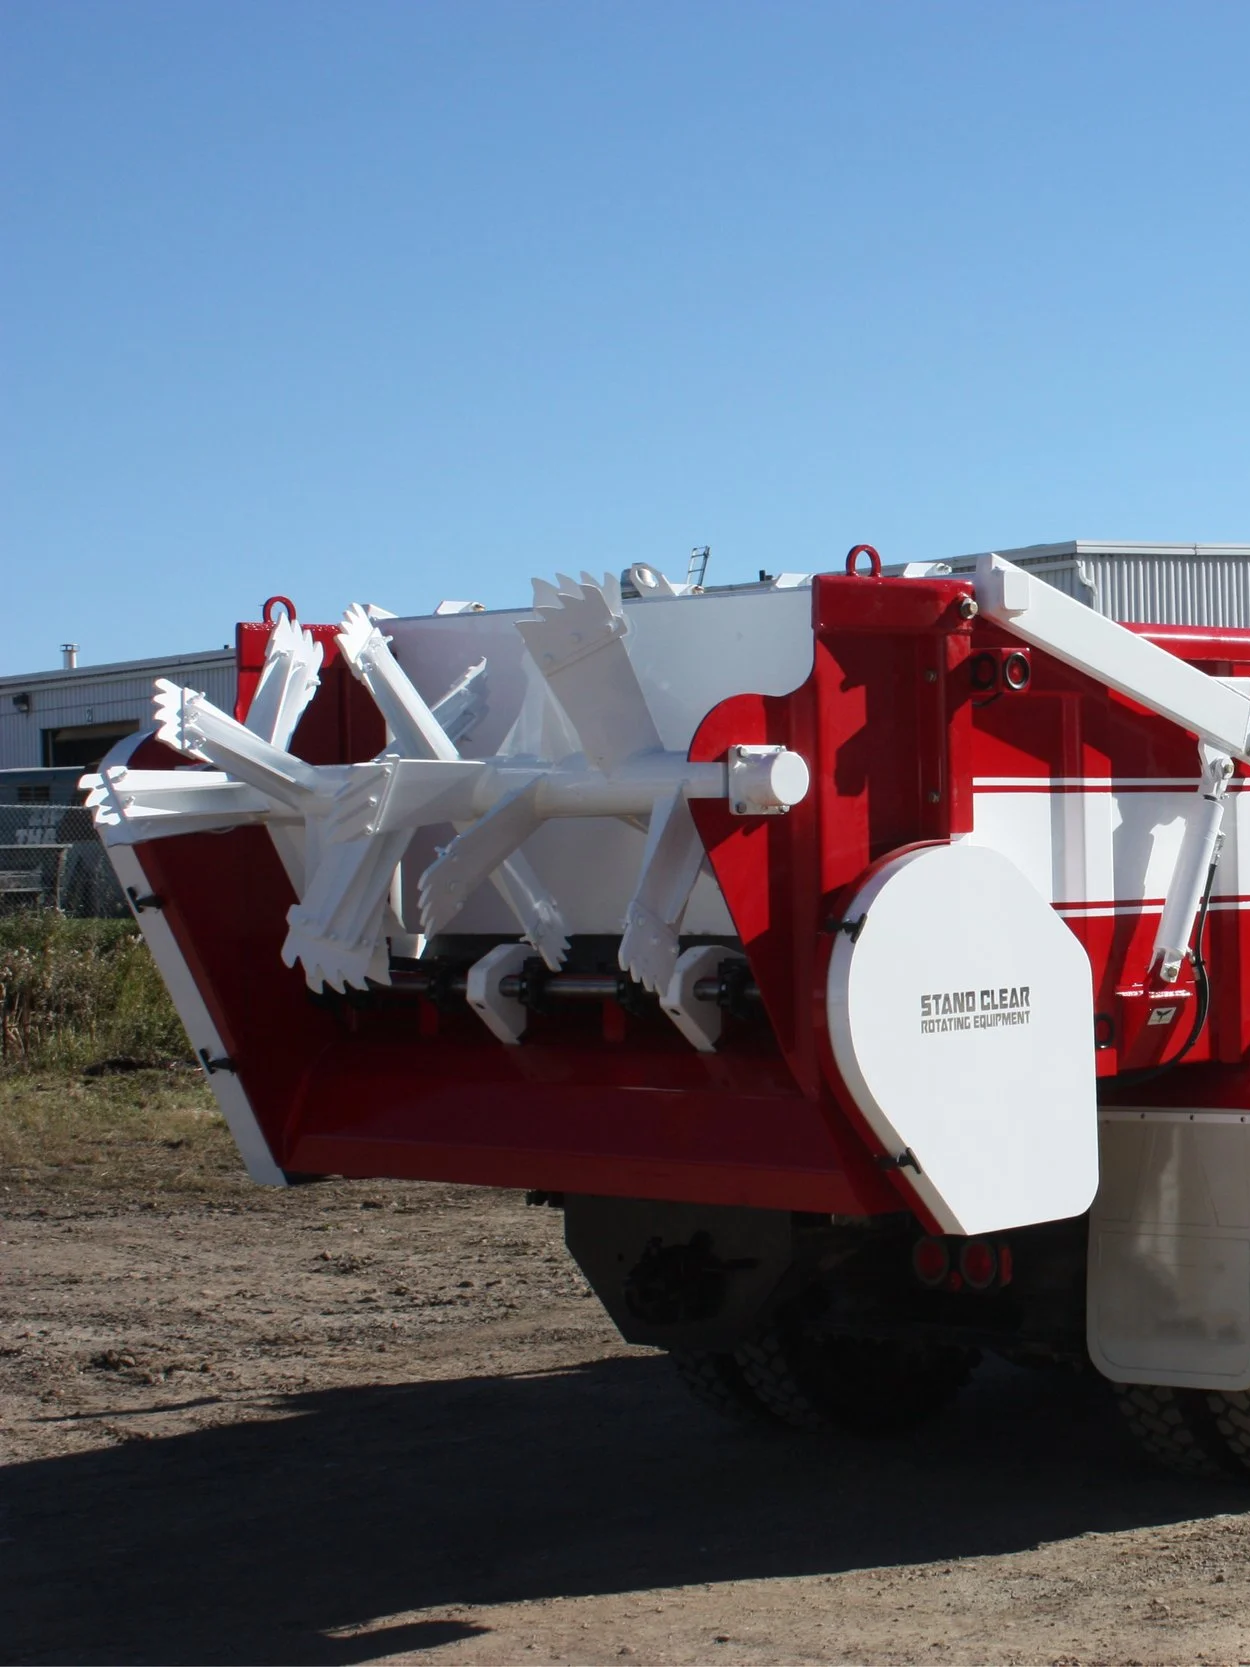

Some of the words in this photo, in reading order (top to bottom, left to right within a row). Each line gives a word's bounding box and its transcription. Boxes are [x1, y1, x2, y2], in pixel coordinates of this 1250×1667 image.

[920, 990, 976, 1017] STAND
[979, 986, 1031, 1012] CLEAR
[920, 1016, 971, 1034] ROTATING
[973, 1010, 1031, 1030] EQUIPMENT
